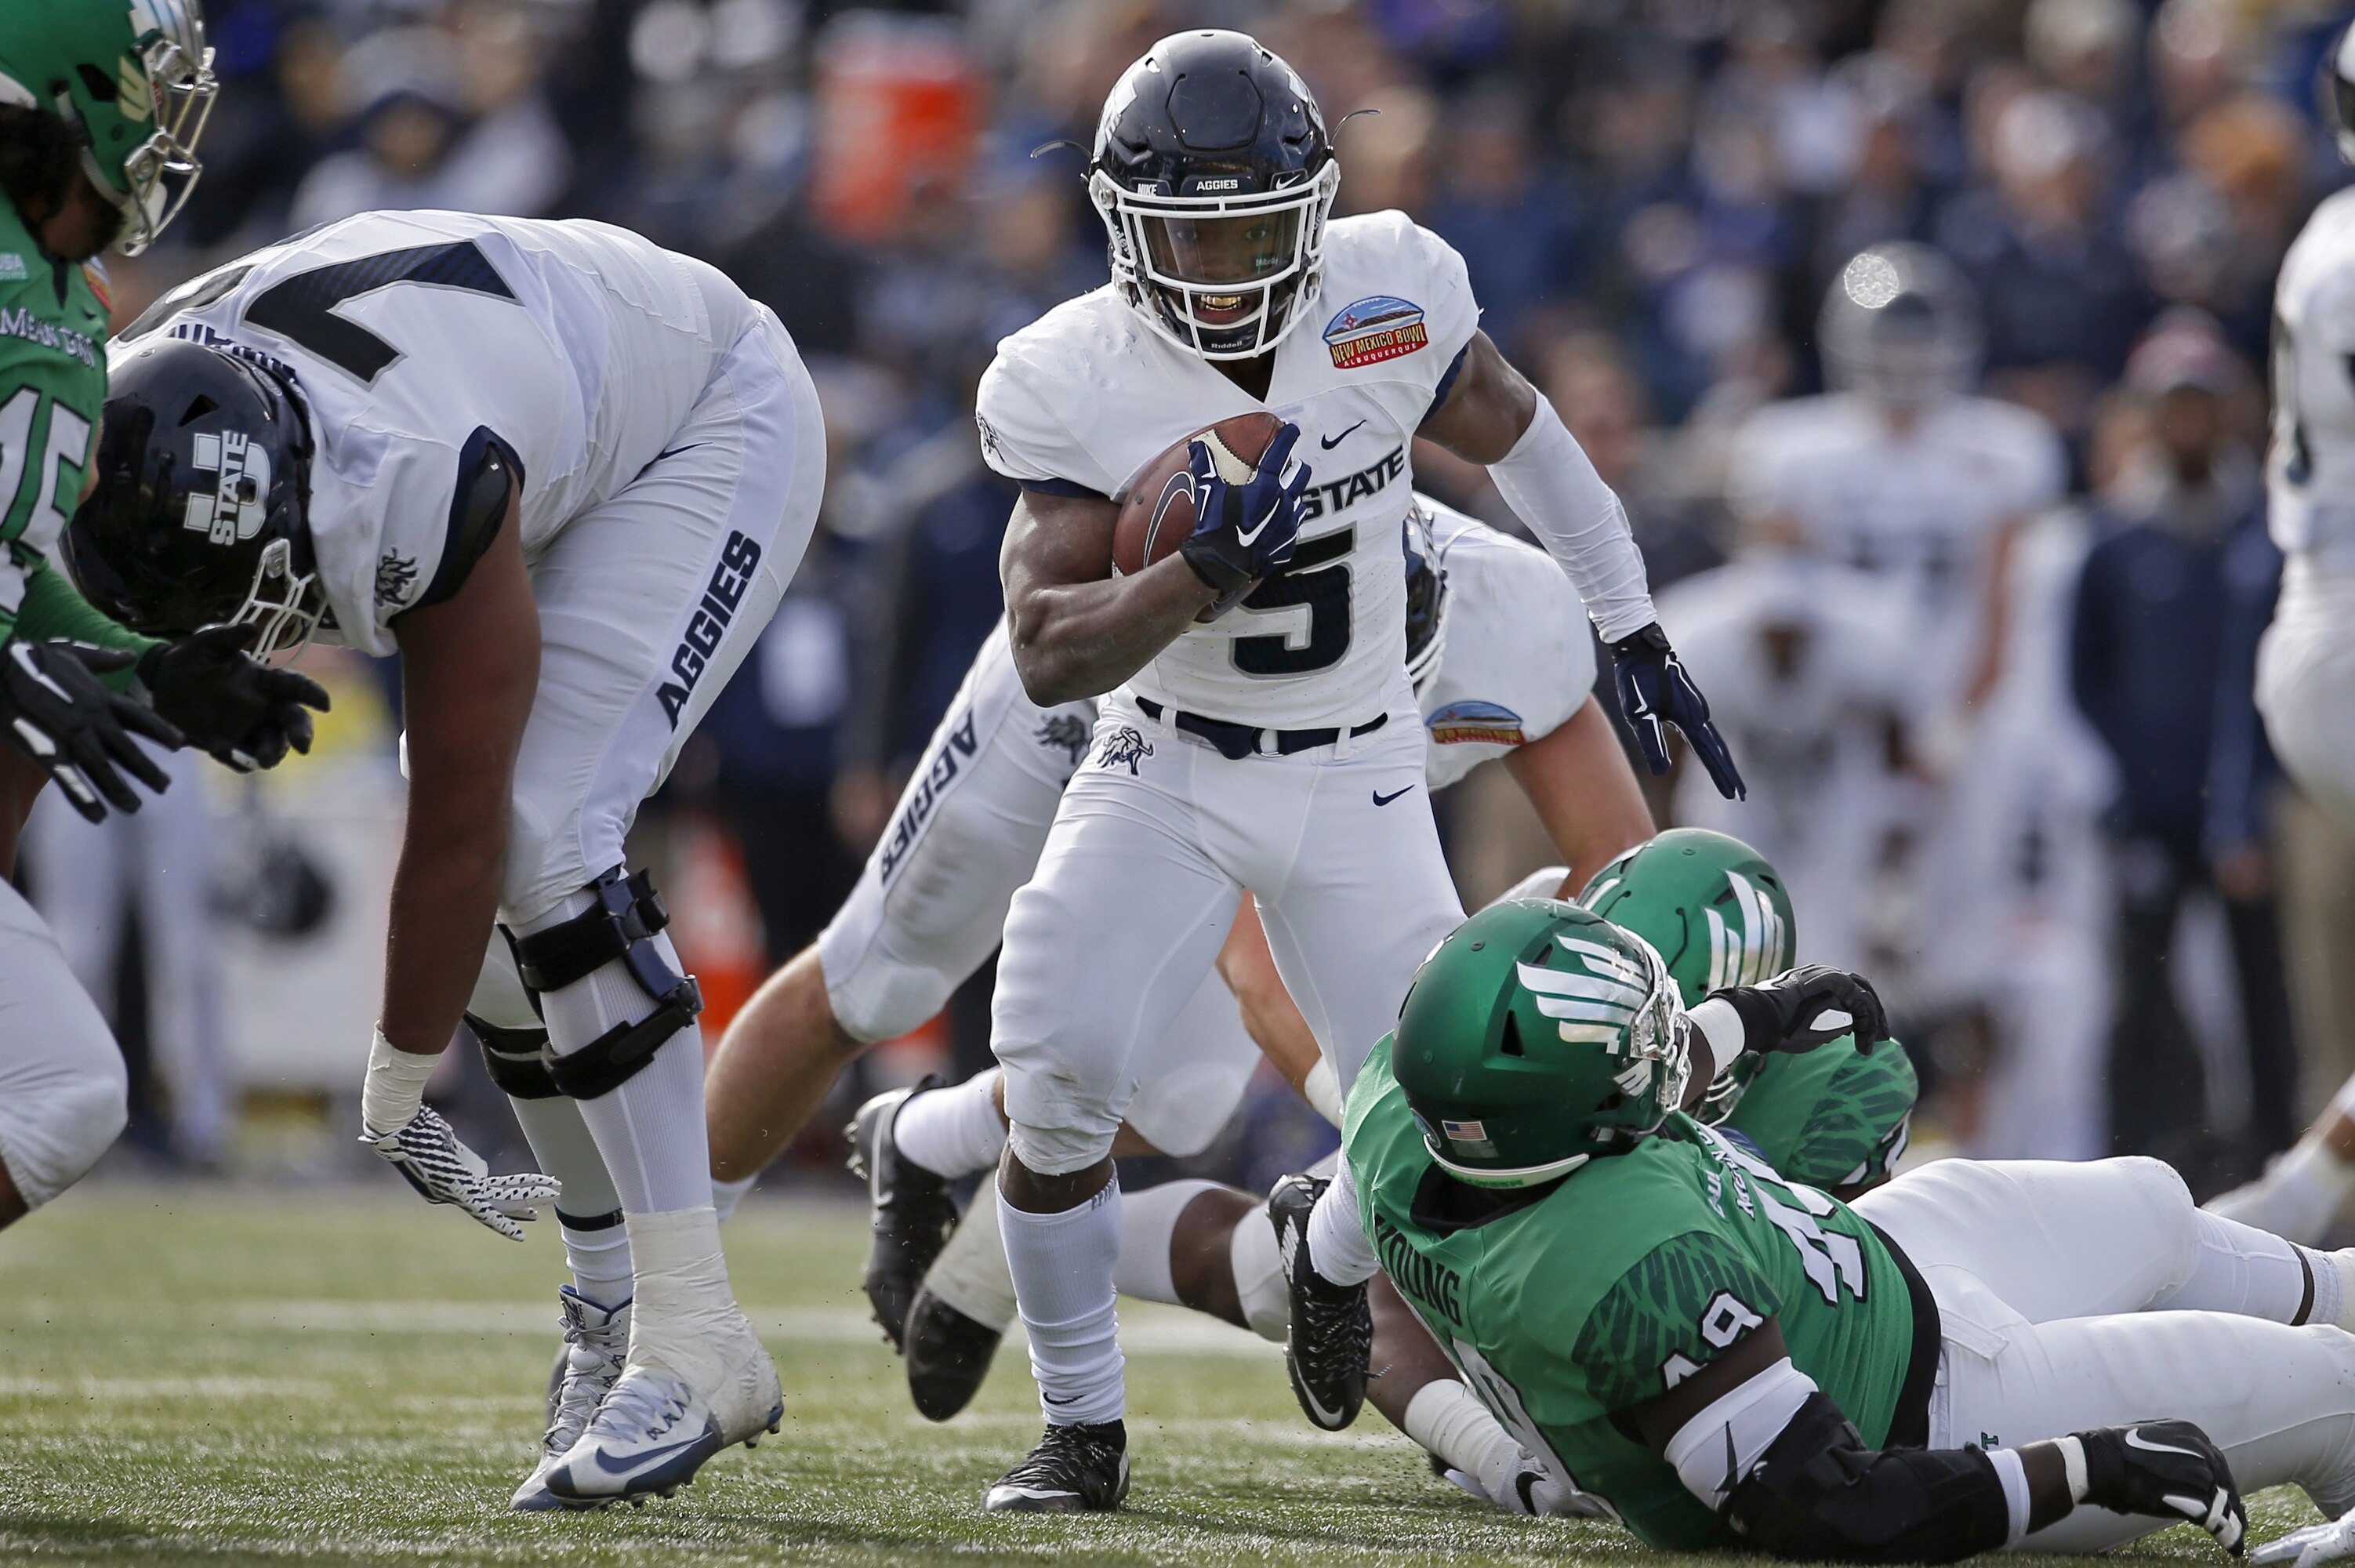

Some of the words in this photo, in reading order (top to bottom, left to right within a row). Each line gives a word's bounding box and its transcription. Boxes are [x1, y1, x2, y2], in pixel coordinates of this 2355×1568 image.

[1137, 183, 1158, 196] NIKE
[1196, 180, 1239, 191] AGGIES
[1210, 340, 1243, 349] Riddell
[1331, 343, 1355, 365] NEW
[1355, 332, 1394, 354] MEXICO
[1395, 325, 1427, 344] BOWL
[1344, 343, 1417, 367] ALBUQUERQUE
[209, 430, 248, 546] STATE
[1300, 442, 1405, 523] STATE
[1228, 521, 1358, 681] 5
[655, 529, 761, 735] AGGIES
[1374, 1212, 1464, 1328] YOUNG
